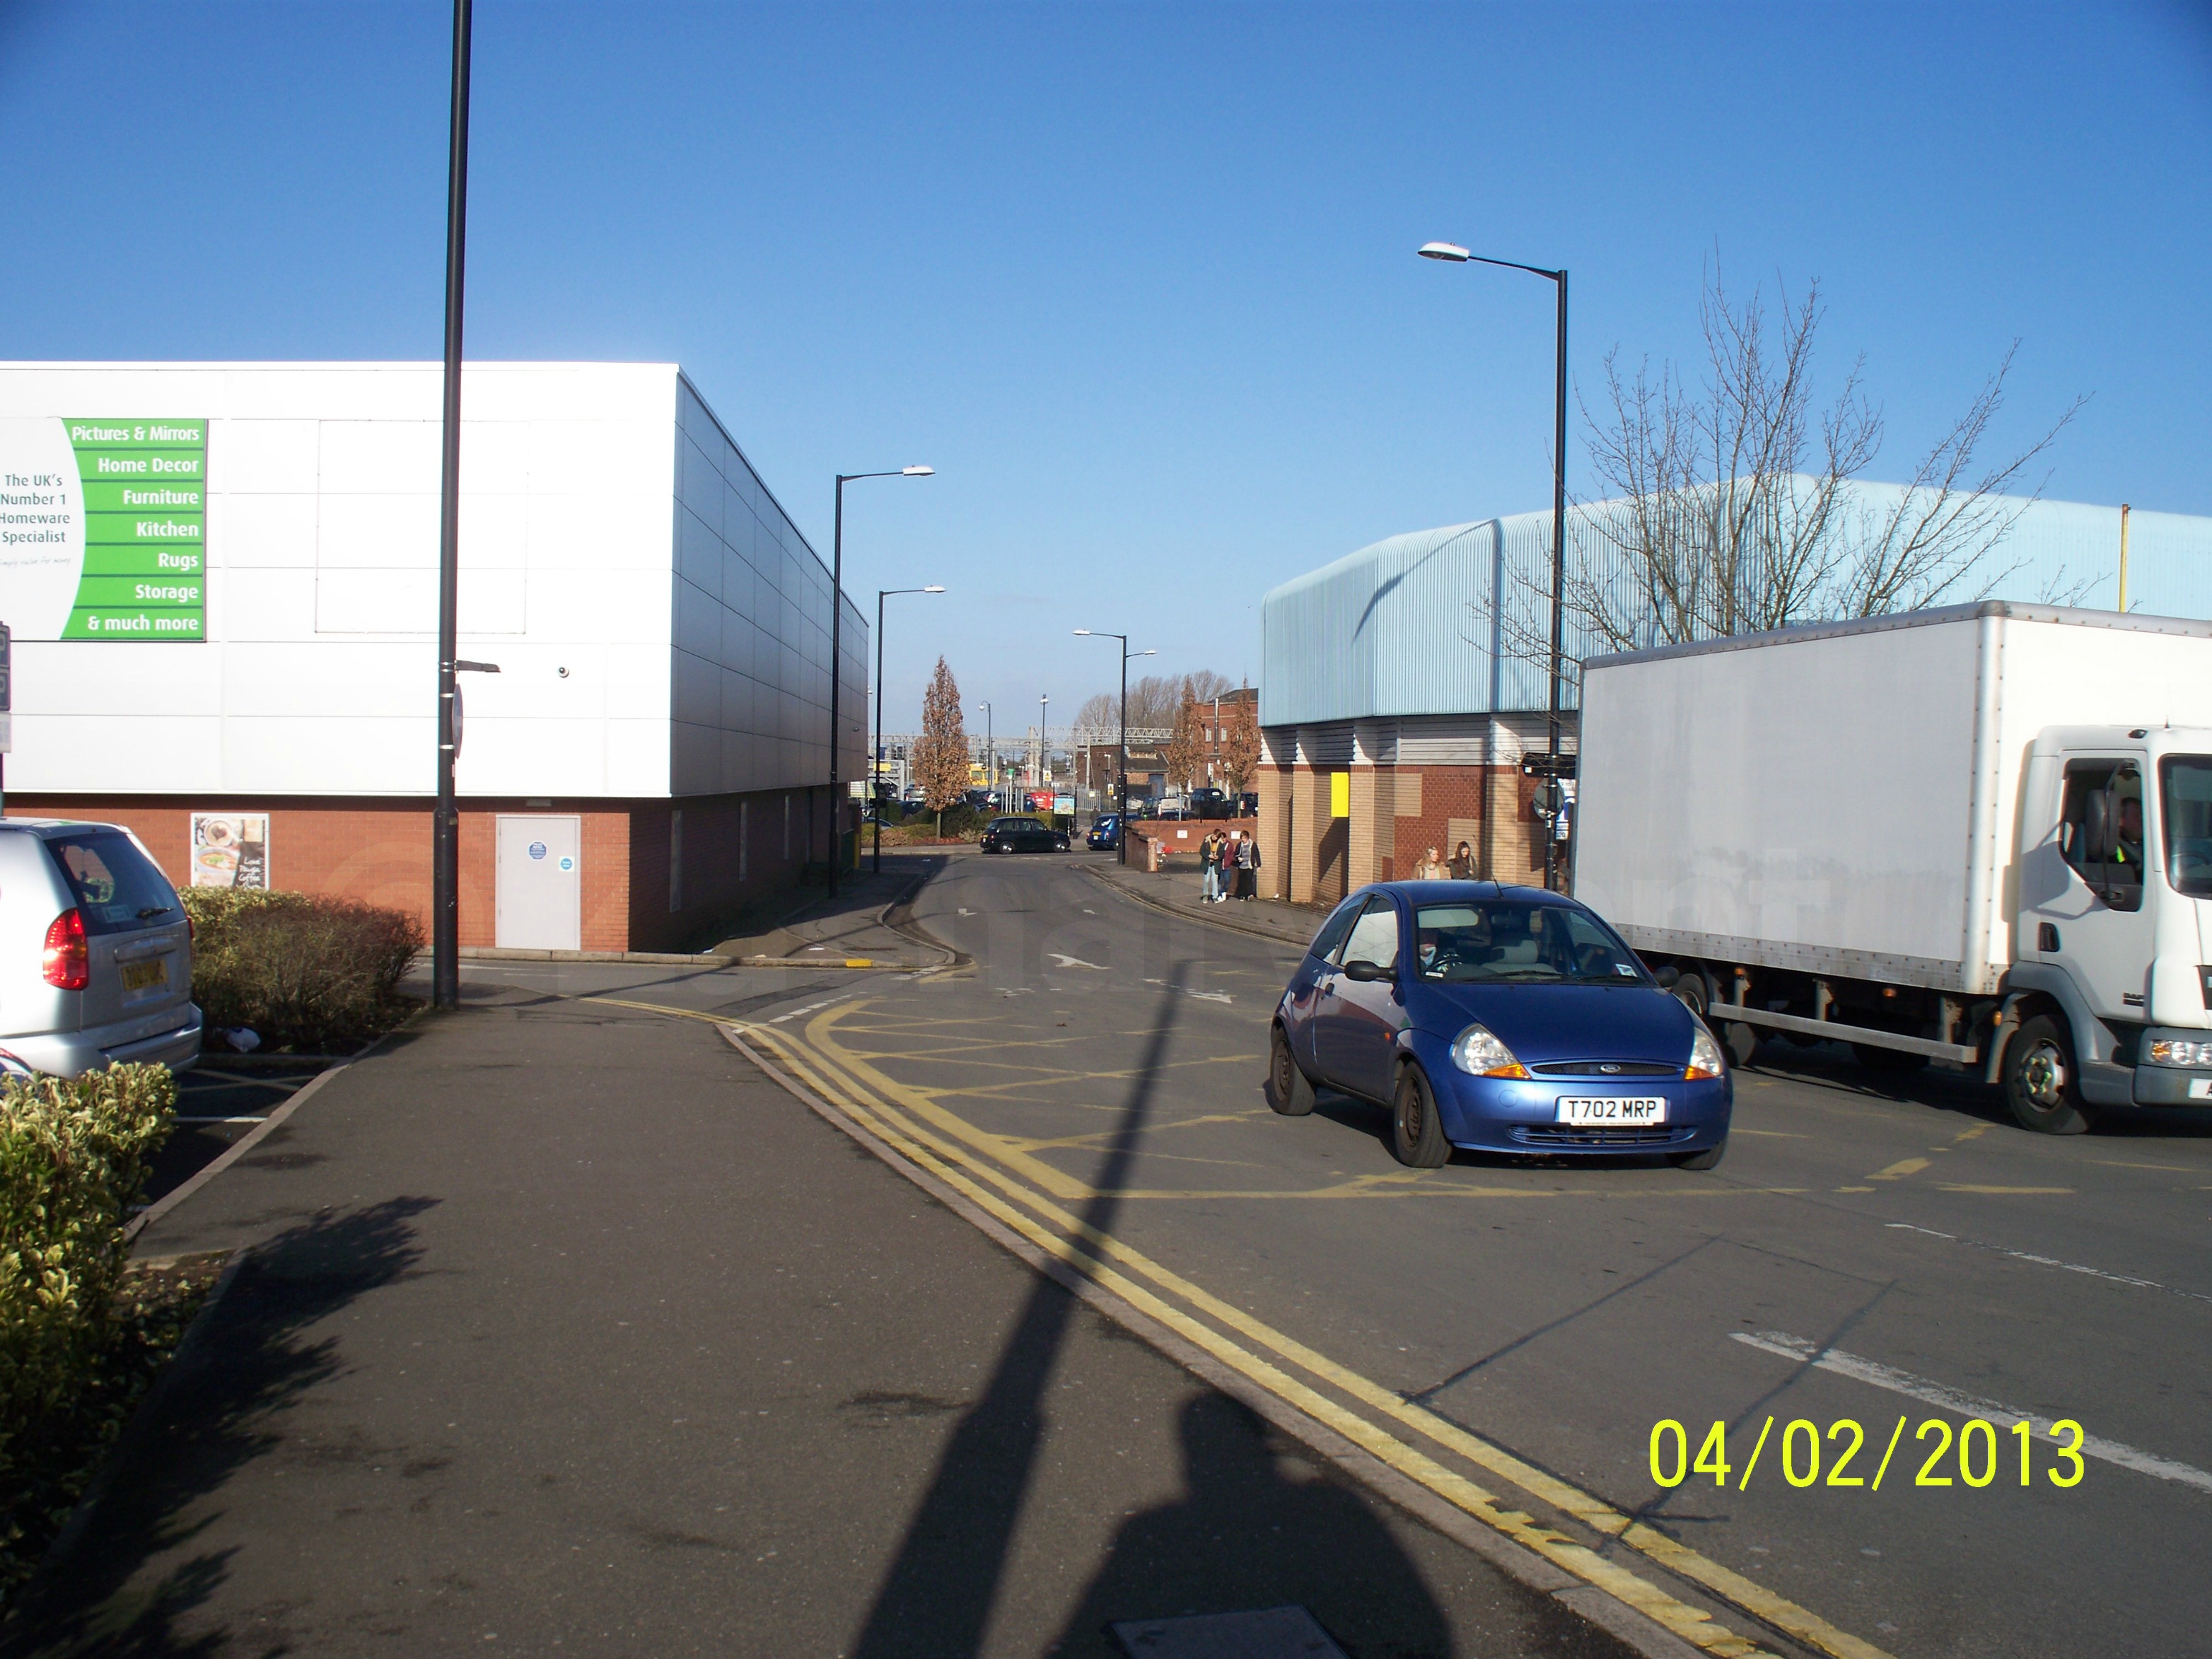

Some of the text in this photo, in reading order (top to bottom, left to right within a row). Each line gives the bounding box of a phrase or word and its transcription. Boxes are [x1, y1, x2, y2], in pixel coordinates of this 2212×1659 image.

[72, 426, 199, 441] Pictures & Mirrors
[98, 458, 199, 473] Home Decor
[5, 473, 62, 487] The UK's
[0, 492, 66, 505] Number 1
[123, 489, 199, 505] Furniture
[0, 512, 70, 524] Homeware
[136, 520, 199, 537] Kitchen
[2, 530, 66, 546] Specialist
[158, 553, 198, 571] Rugs
[135, 585, 198, 603] Storage
[88, 614, 198, 630] & much more
[1568, 1100, 1655, 1118] T702 MRP
